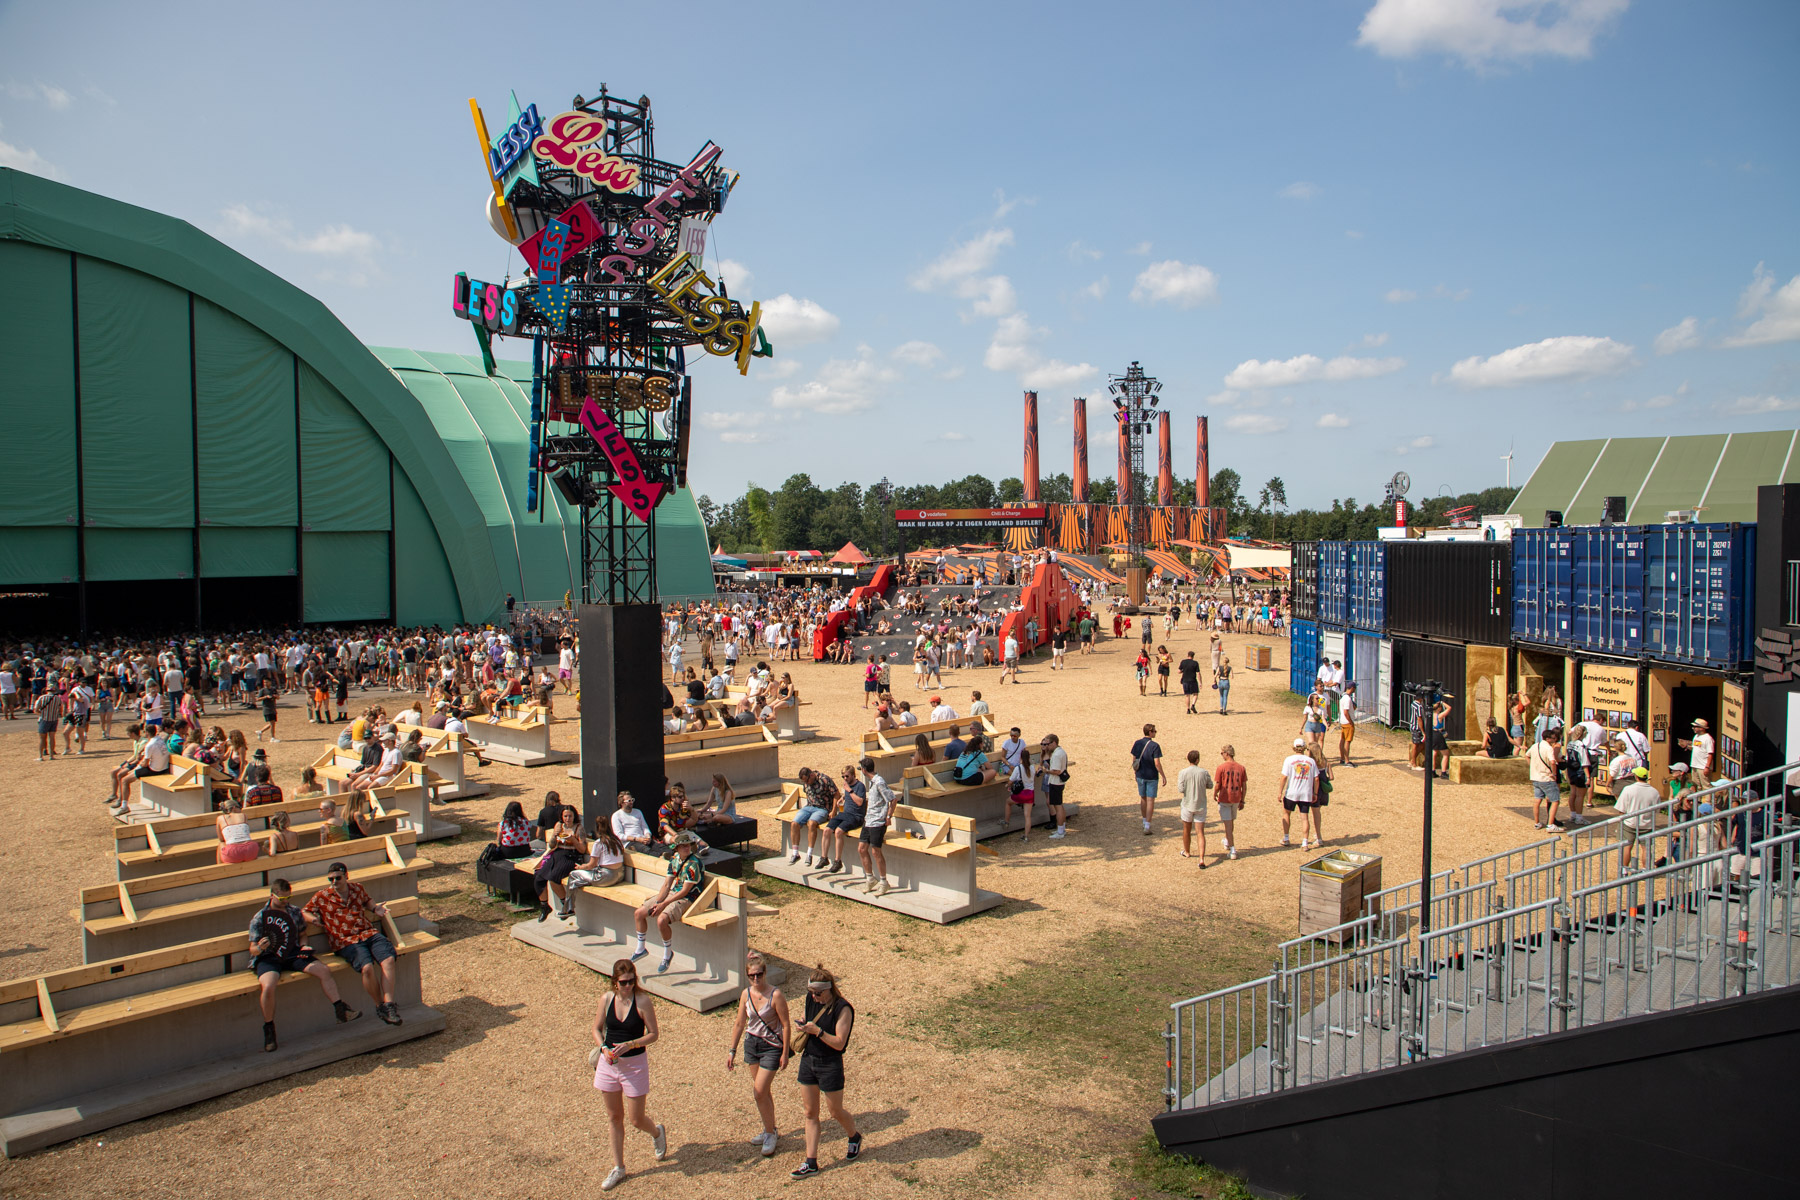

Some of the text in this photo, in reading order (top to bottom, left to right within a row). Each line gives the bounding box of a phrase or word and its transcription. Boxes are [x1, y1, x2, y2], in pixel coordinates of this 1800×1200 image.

[488, 103, 544, 181] LESS!
[536, 115, 638, 190] Less
[541, 231, 563, 285] LESS
[686, 227, 706, 256] LESS
[453, 275, 516, 327] LESS
[647, 251, 750, 357] LESS
[559, 373, 672, 412] LESS
[586, 410, 650, 511] LESS
[781, 560, 834, 574] SNACKS
[1583, 674, 1635, 687] America Today
[1597, 686, 1620, 695] Model
[1591, 695, 1627, 706] Tomorrow
[267, 916, 290, 933] DICKS
